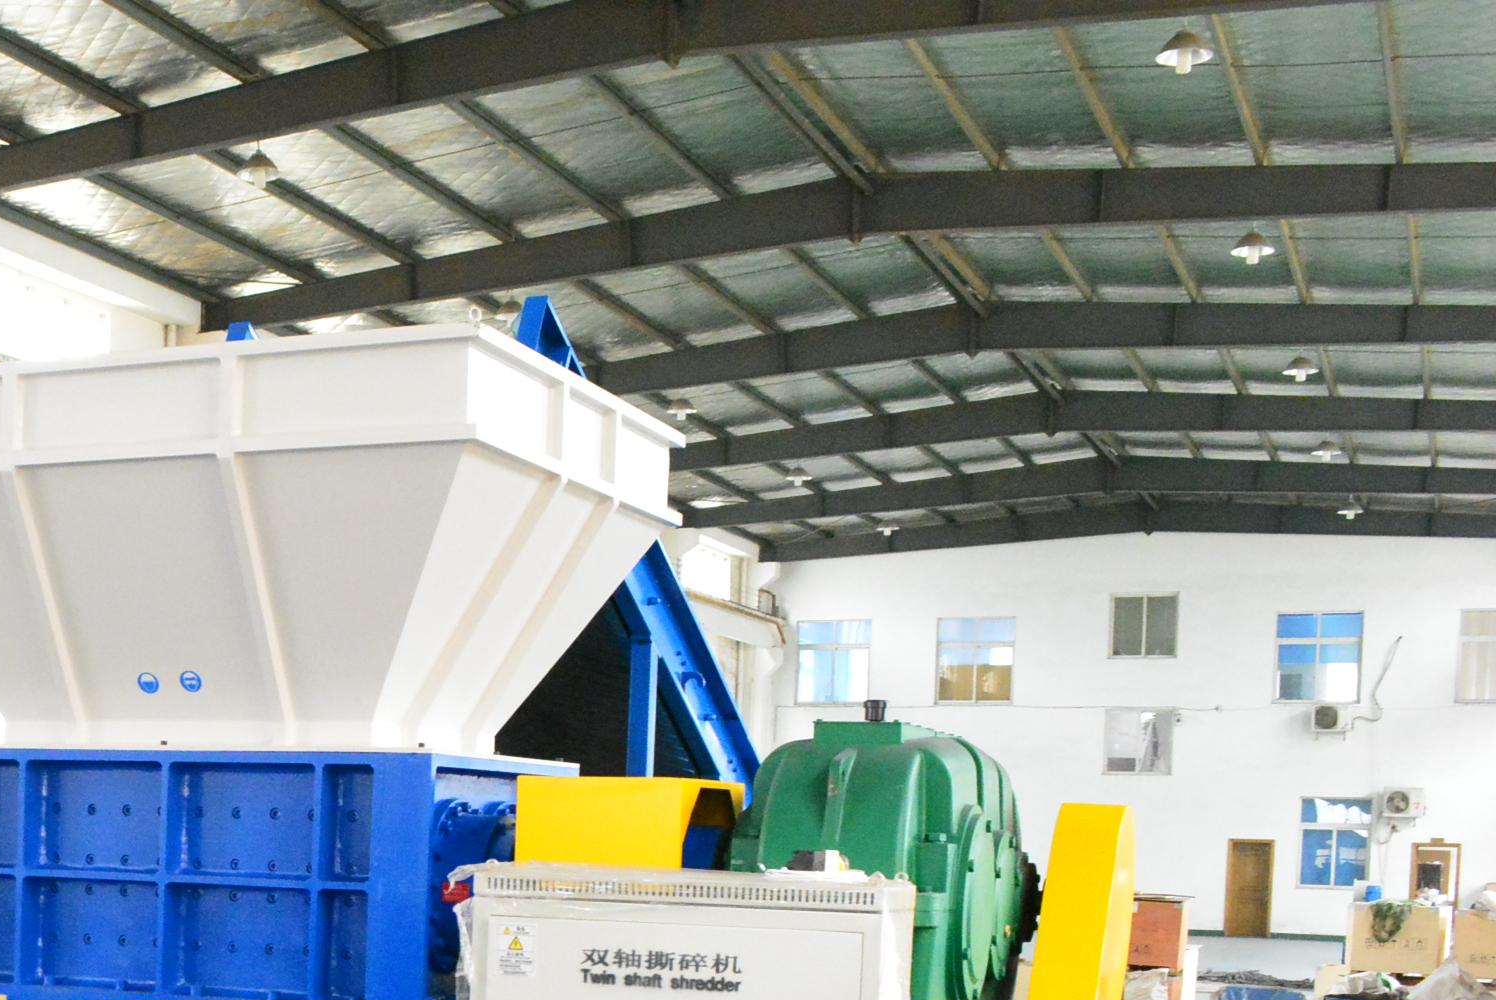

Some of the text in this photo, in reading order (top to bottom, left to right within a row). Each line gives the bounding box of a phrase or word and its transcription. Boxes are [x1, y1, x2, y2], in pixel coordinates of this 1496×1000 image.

[580, 948, 742, 974] 双轴撕碎机
[580, 968, 742, 992] Twin shaft shredder
